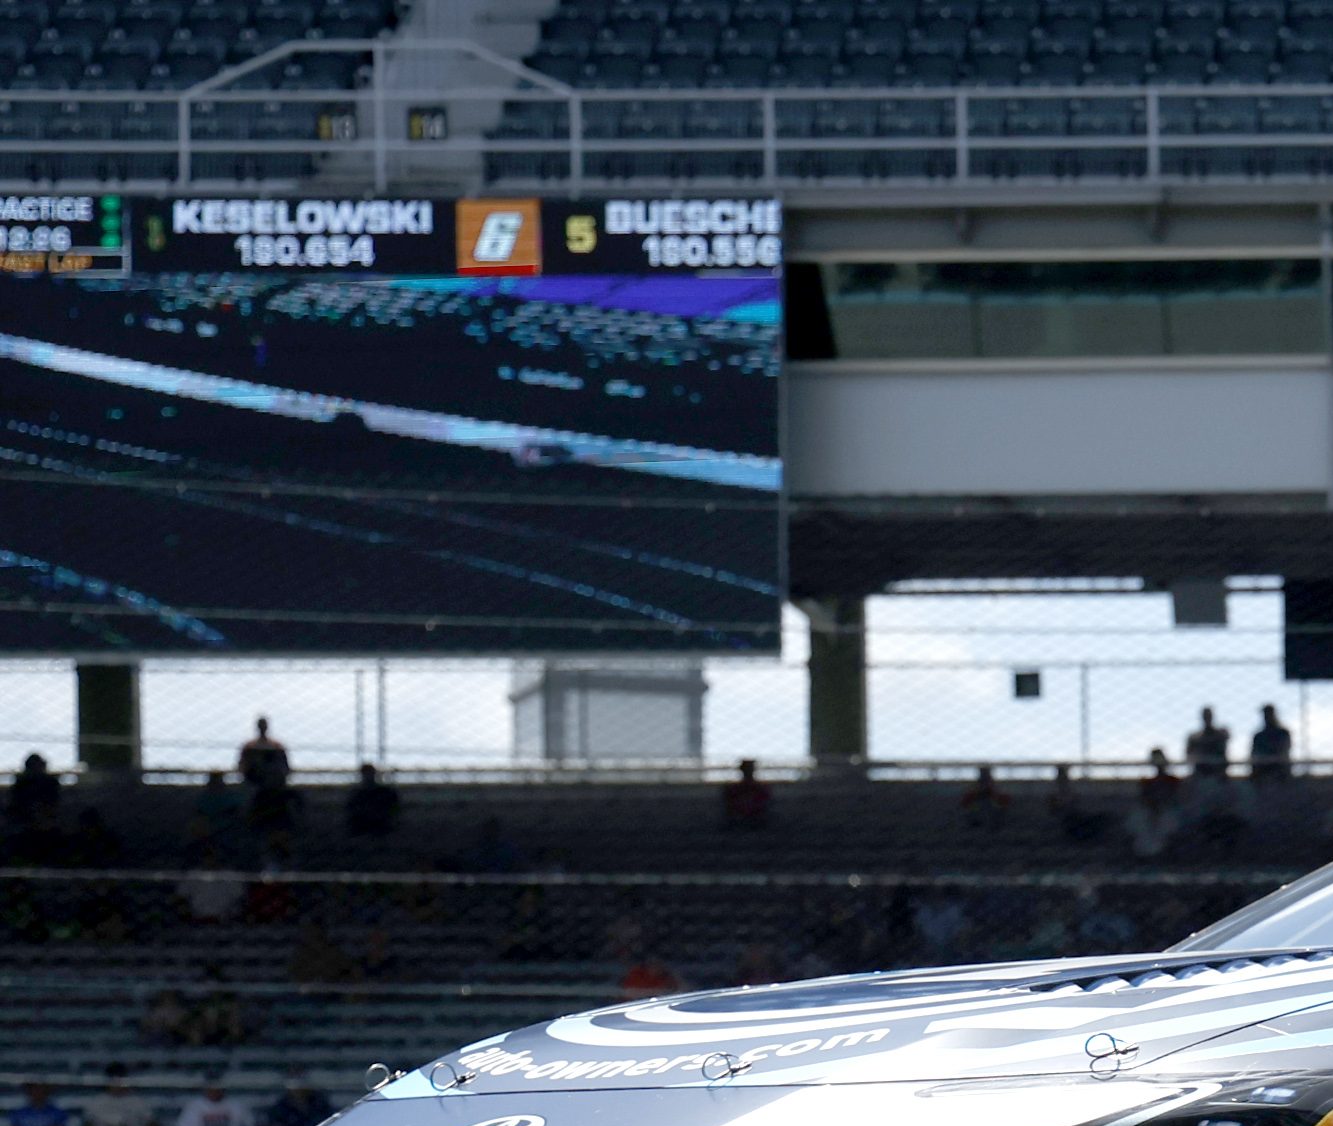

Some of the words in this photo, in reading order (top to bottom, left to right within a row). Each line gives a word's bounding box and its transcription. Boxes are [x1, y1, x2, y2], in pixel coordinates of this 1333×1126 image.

[172, 200, 434, 234] KESELOWSKI
[472, 210, 524, 262] 6
[565, 215, 597, 254] 5
